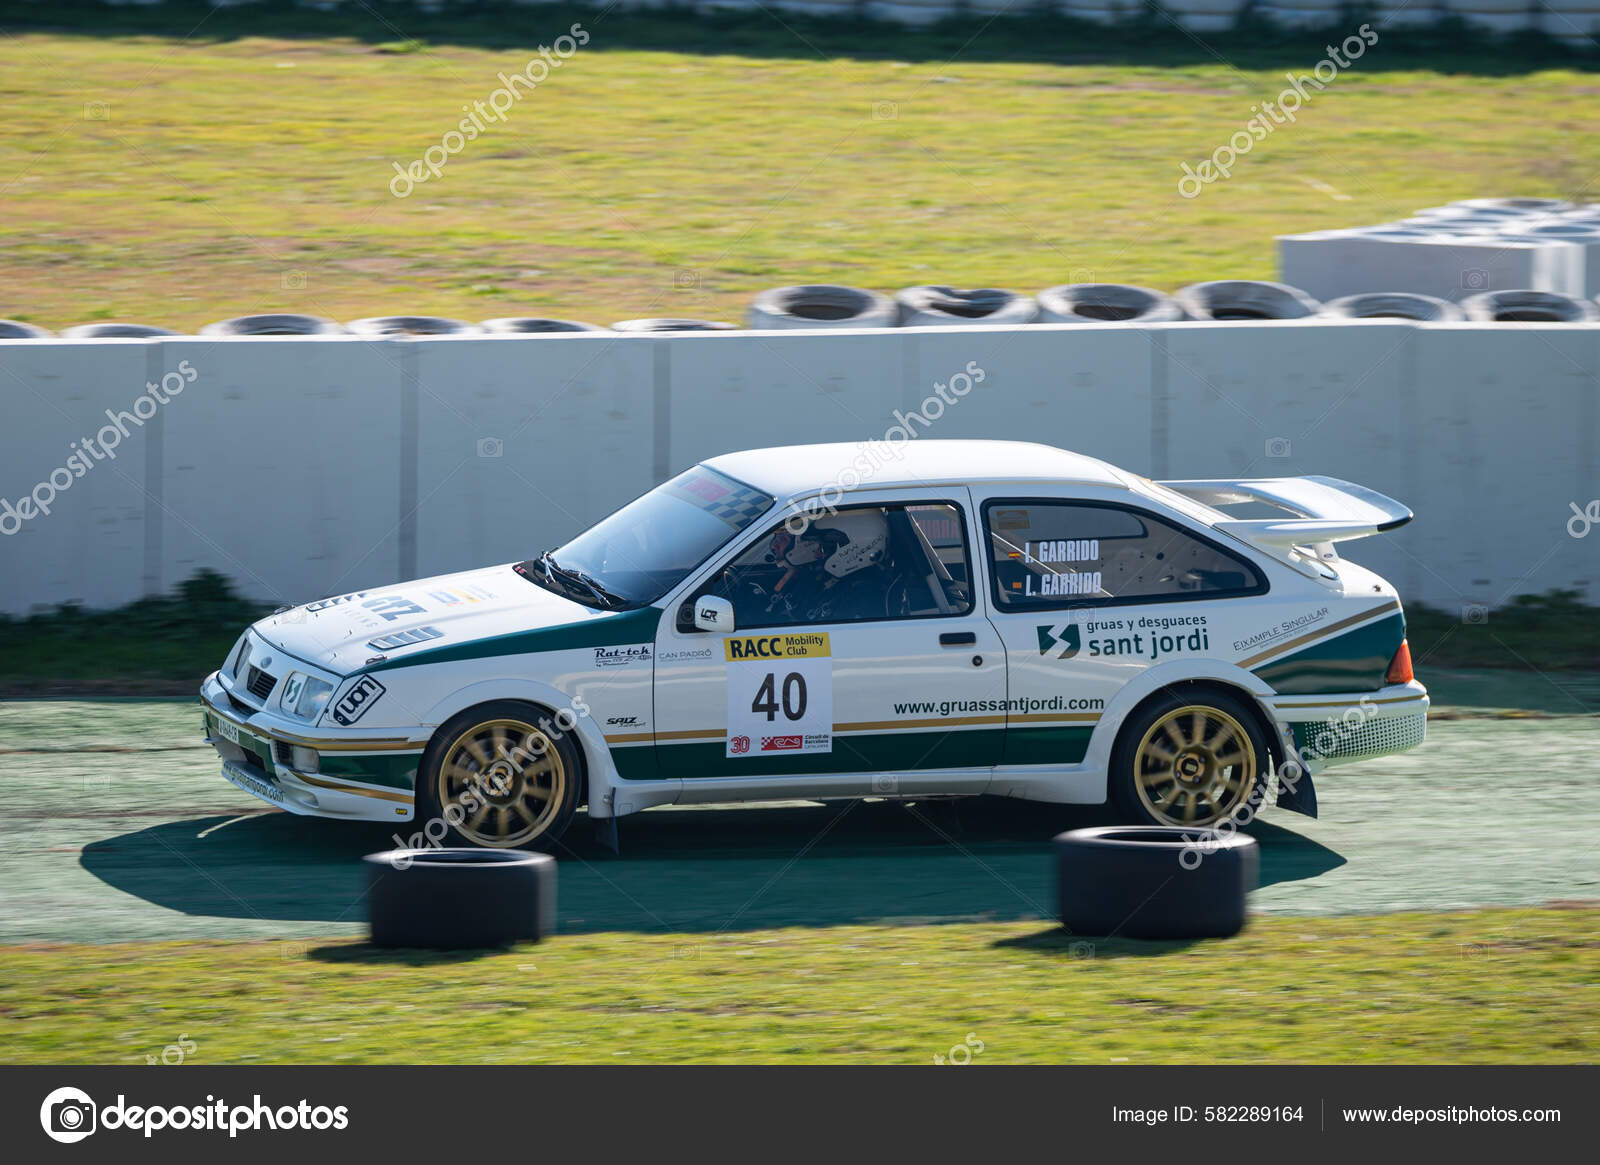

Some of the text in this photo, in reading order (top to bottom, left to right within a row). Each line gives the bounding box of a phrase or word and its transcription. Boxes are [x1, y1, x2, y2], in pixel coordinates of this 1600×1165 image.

[1039, 540, 1099, 562] GARRIDO
[1025, 572, 1101, 596] L. GARRIDO
[1086, 615, 1207, 633] gruas y desguaces
[1233, 626, 1280, 651] EIXAMPLE
[1281, 607, 1329, 632] SINGULAR
[730, 637, 783, 658] RACC
[785, 634, 824, 647] Mobility
[786, 646, 808, 656] Club
[1089, 628, 1209, 659] sant jordi
[752, 672, 808, 721] 40
[894, 696, 1104, 716] www.gruassantjordi.com
[730, 735, 751, 753] 30
